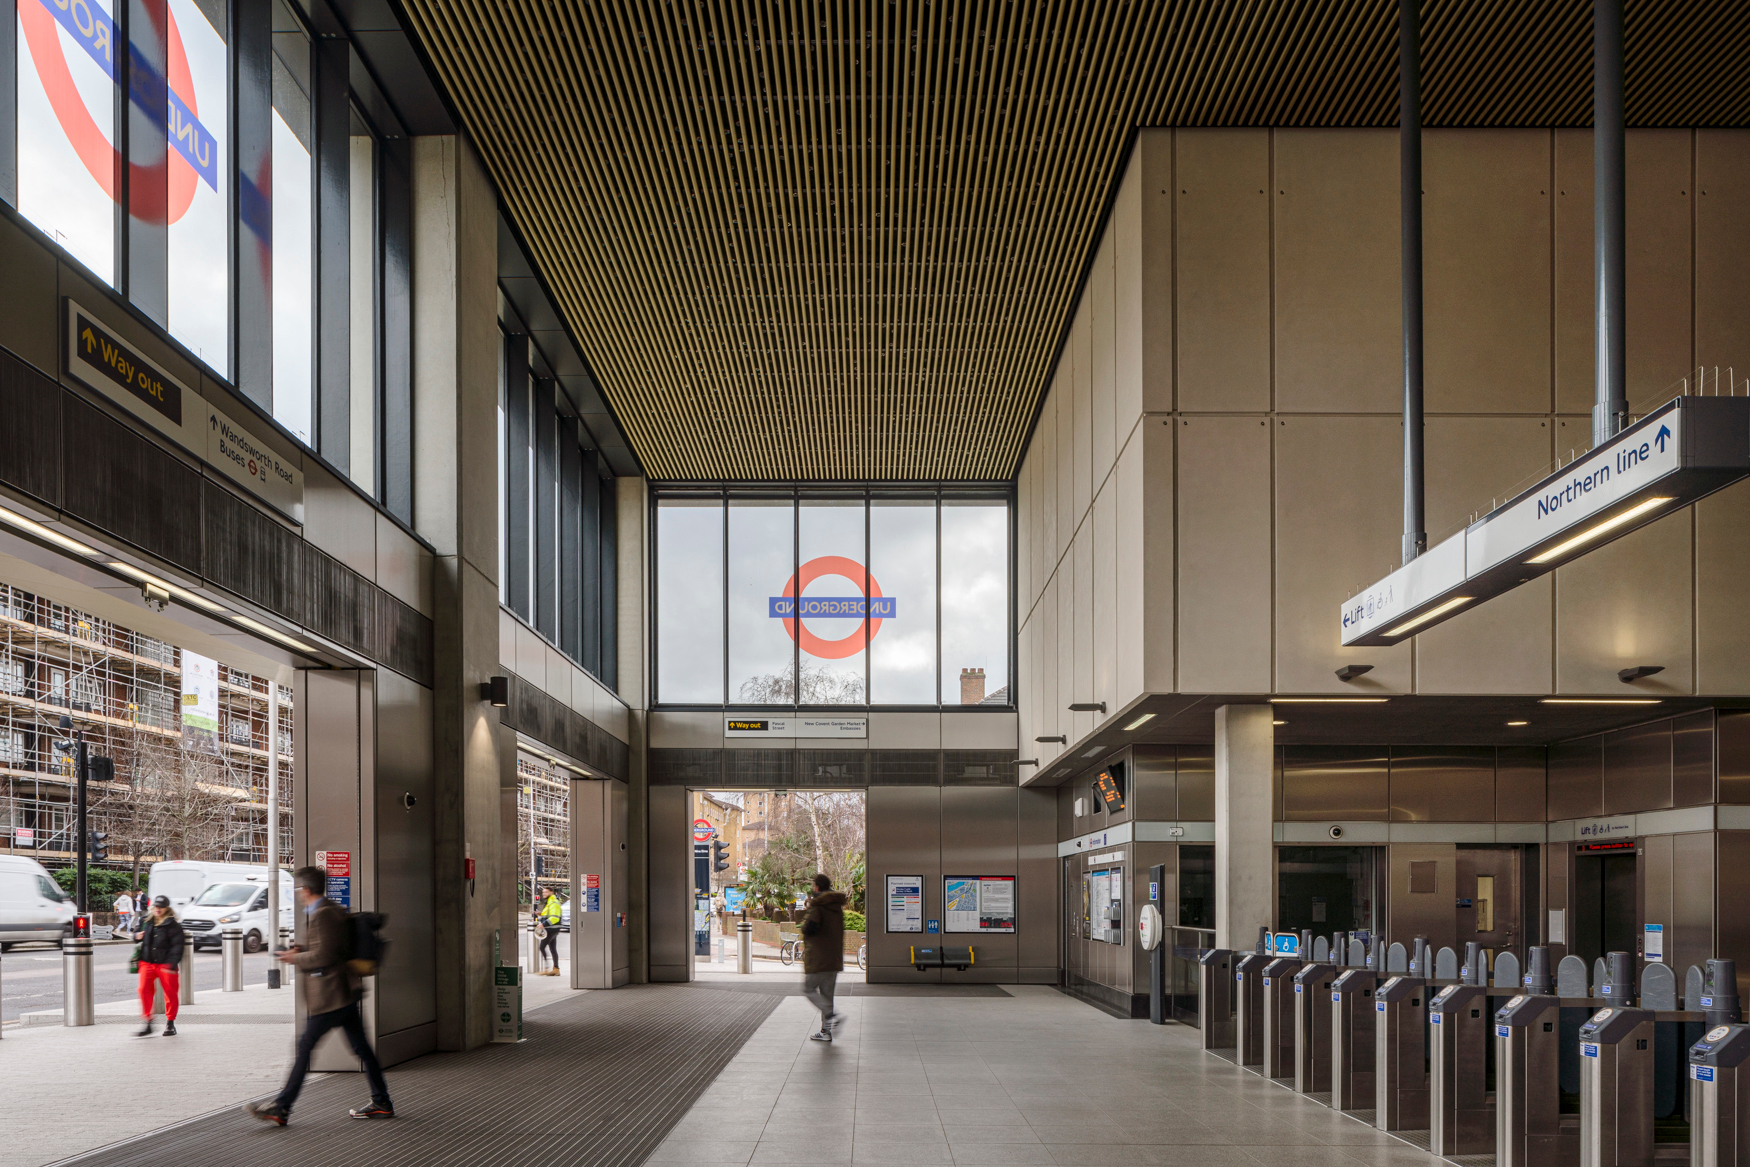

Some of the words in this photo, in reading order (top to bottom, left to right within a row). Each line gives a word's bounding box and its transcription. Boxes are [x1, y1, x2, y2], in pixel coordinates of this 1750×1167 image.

[101, 338, 135, 383] Way
[138, 372, 164, 402] out
[219, 420, 273, 470] Wandsworth
[274, 461, 293, 485] Road
[219, 438, 245, 468] Buses
[1537, 464, 1610, 519] Northern
[1616, 442, 1650, 475] line
[1351, 605, 1364, 625] Lift
[1581, 826, 1590, 835] Lift
